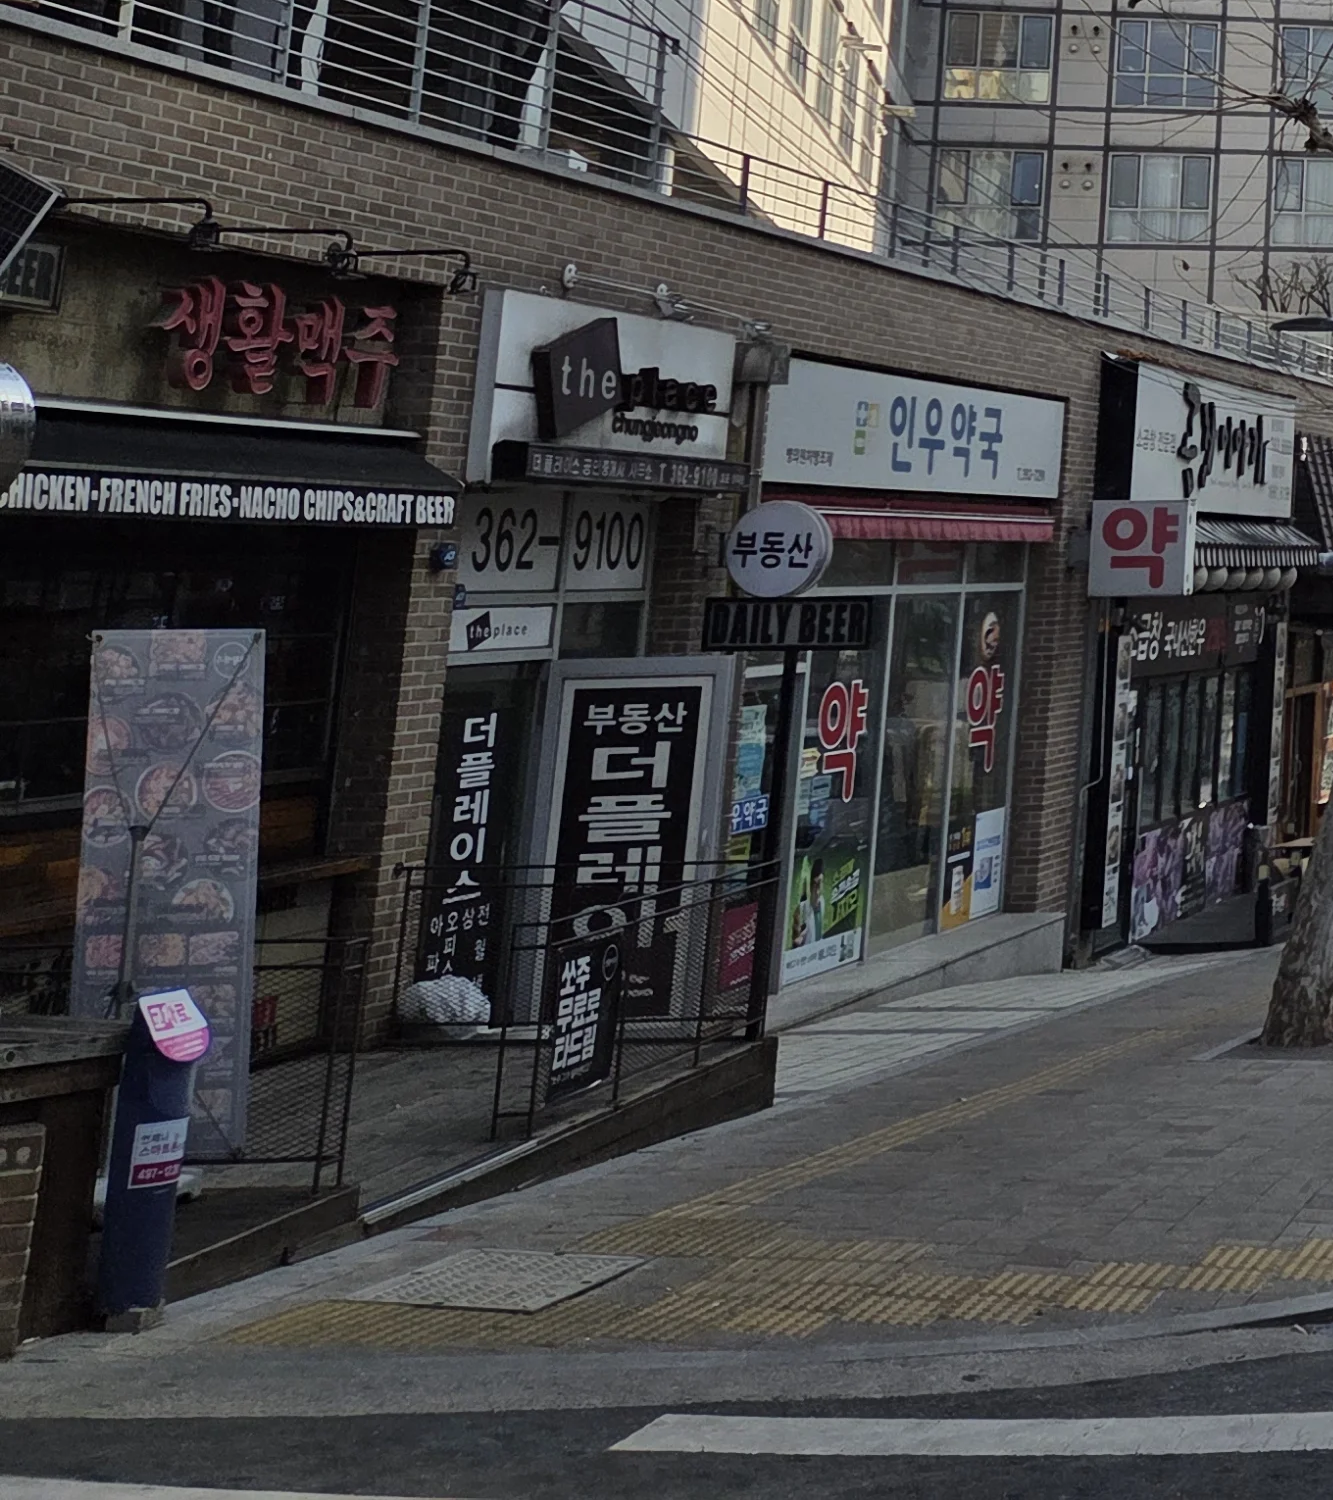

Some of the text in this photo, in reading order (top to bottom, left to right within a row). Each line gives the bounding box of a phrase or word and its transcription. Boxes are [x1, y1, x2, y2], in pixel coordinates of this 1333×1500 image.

[160, 275, 400, 408] 생활맥주
[561, 356, 616, 400] the
[628, 368, 718, 411] place
[888, 395, 1004, 480] 인우약국
[304, 487, 412, 523] CHIPS&CRAFT
[415, 494, 455, 524] BEER
[471, 507, 644, 572] 362-9100
[732, 532, 813, 569] 부동산
[1103, 507, 1179, 588] 약
[469, 622, 528, 640] the place
[710, 603, 867, 644] DAILY BEER
[583, 702, 688, 736] 부동산
[817, 678, 869, 804] 약
[967, 665, 1004, 773] 약
[443, 711, 499, 906] 더플레이스
